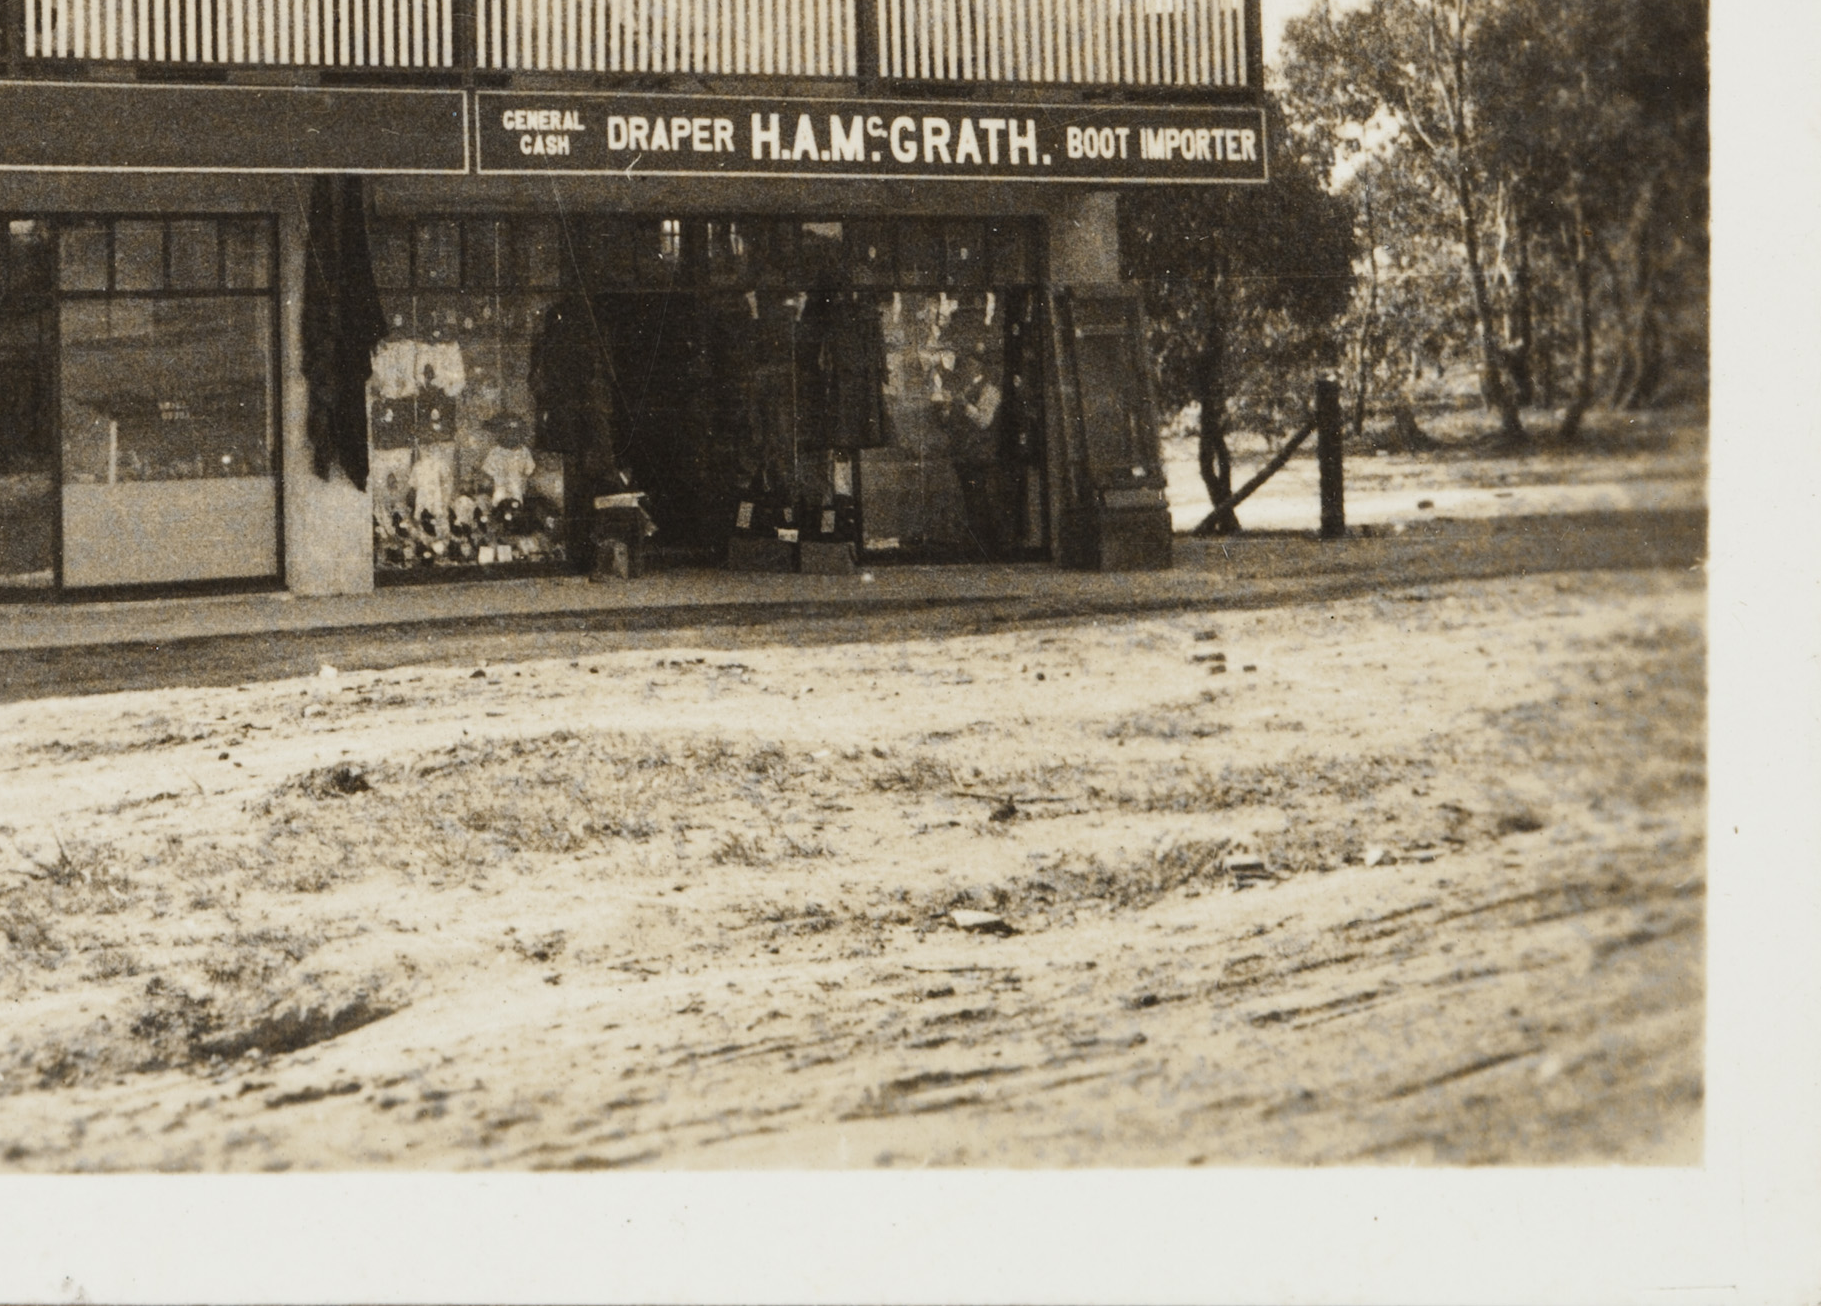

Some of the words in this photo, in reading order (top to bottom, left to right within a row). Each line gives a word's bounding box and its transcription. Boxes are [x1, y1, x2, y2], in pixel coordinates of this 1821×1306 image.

[502, 109, 586, 131] GENERAL
[519, 134, 571, 156] CASH
[606, 115, 736, 153] DRAPER
[1066, 125, 1130, 160] BOOT
[1139, 126, 1257, 162] IMPORTER
